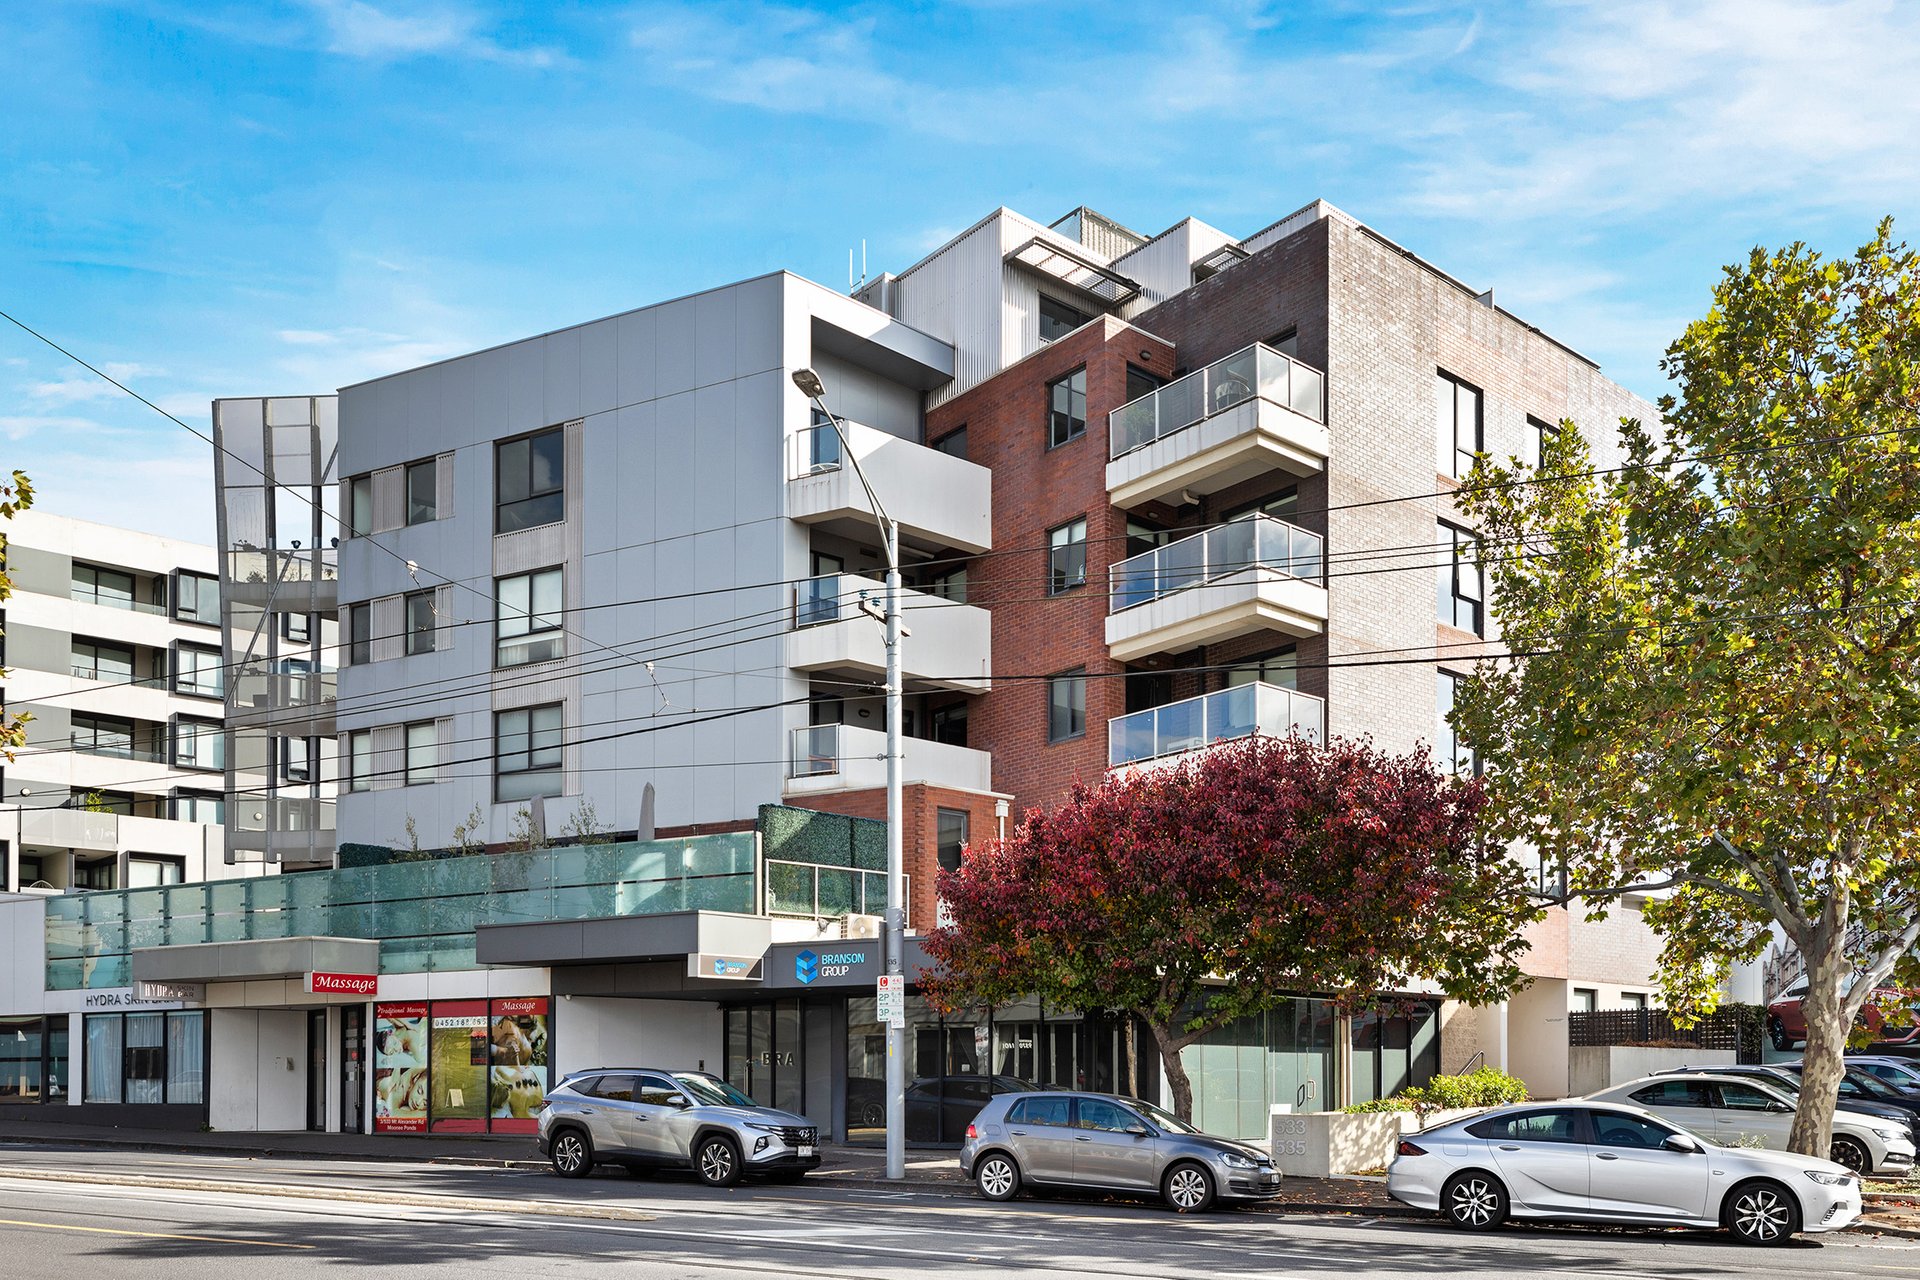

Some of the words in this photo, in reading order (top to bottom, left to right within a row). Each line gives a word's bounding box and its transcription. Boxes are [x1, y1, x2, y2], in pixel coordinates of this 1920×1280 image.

[821, 953, 865, 965] BRANSON
[821, 965, 849, 977] GROUP
[145, 983, 174, 998] HYDRA
[315, 976, 375, 993] Massage
[86, 993, 122, 1006] HYDRA
[879, 993, 889, 1001] 2P
[502, 1001, 536, 1011] Massage
[879, 1008, 889, 1017] 3P
[1275, 1119, 1306, 1134] 533
[1275, 1139, 1306, 1155] 535
